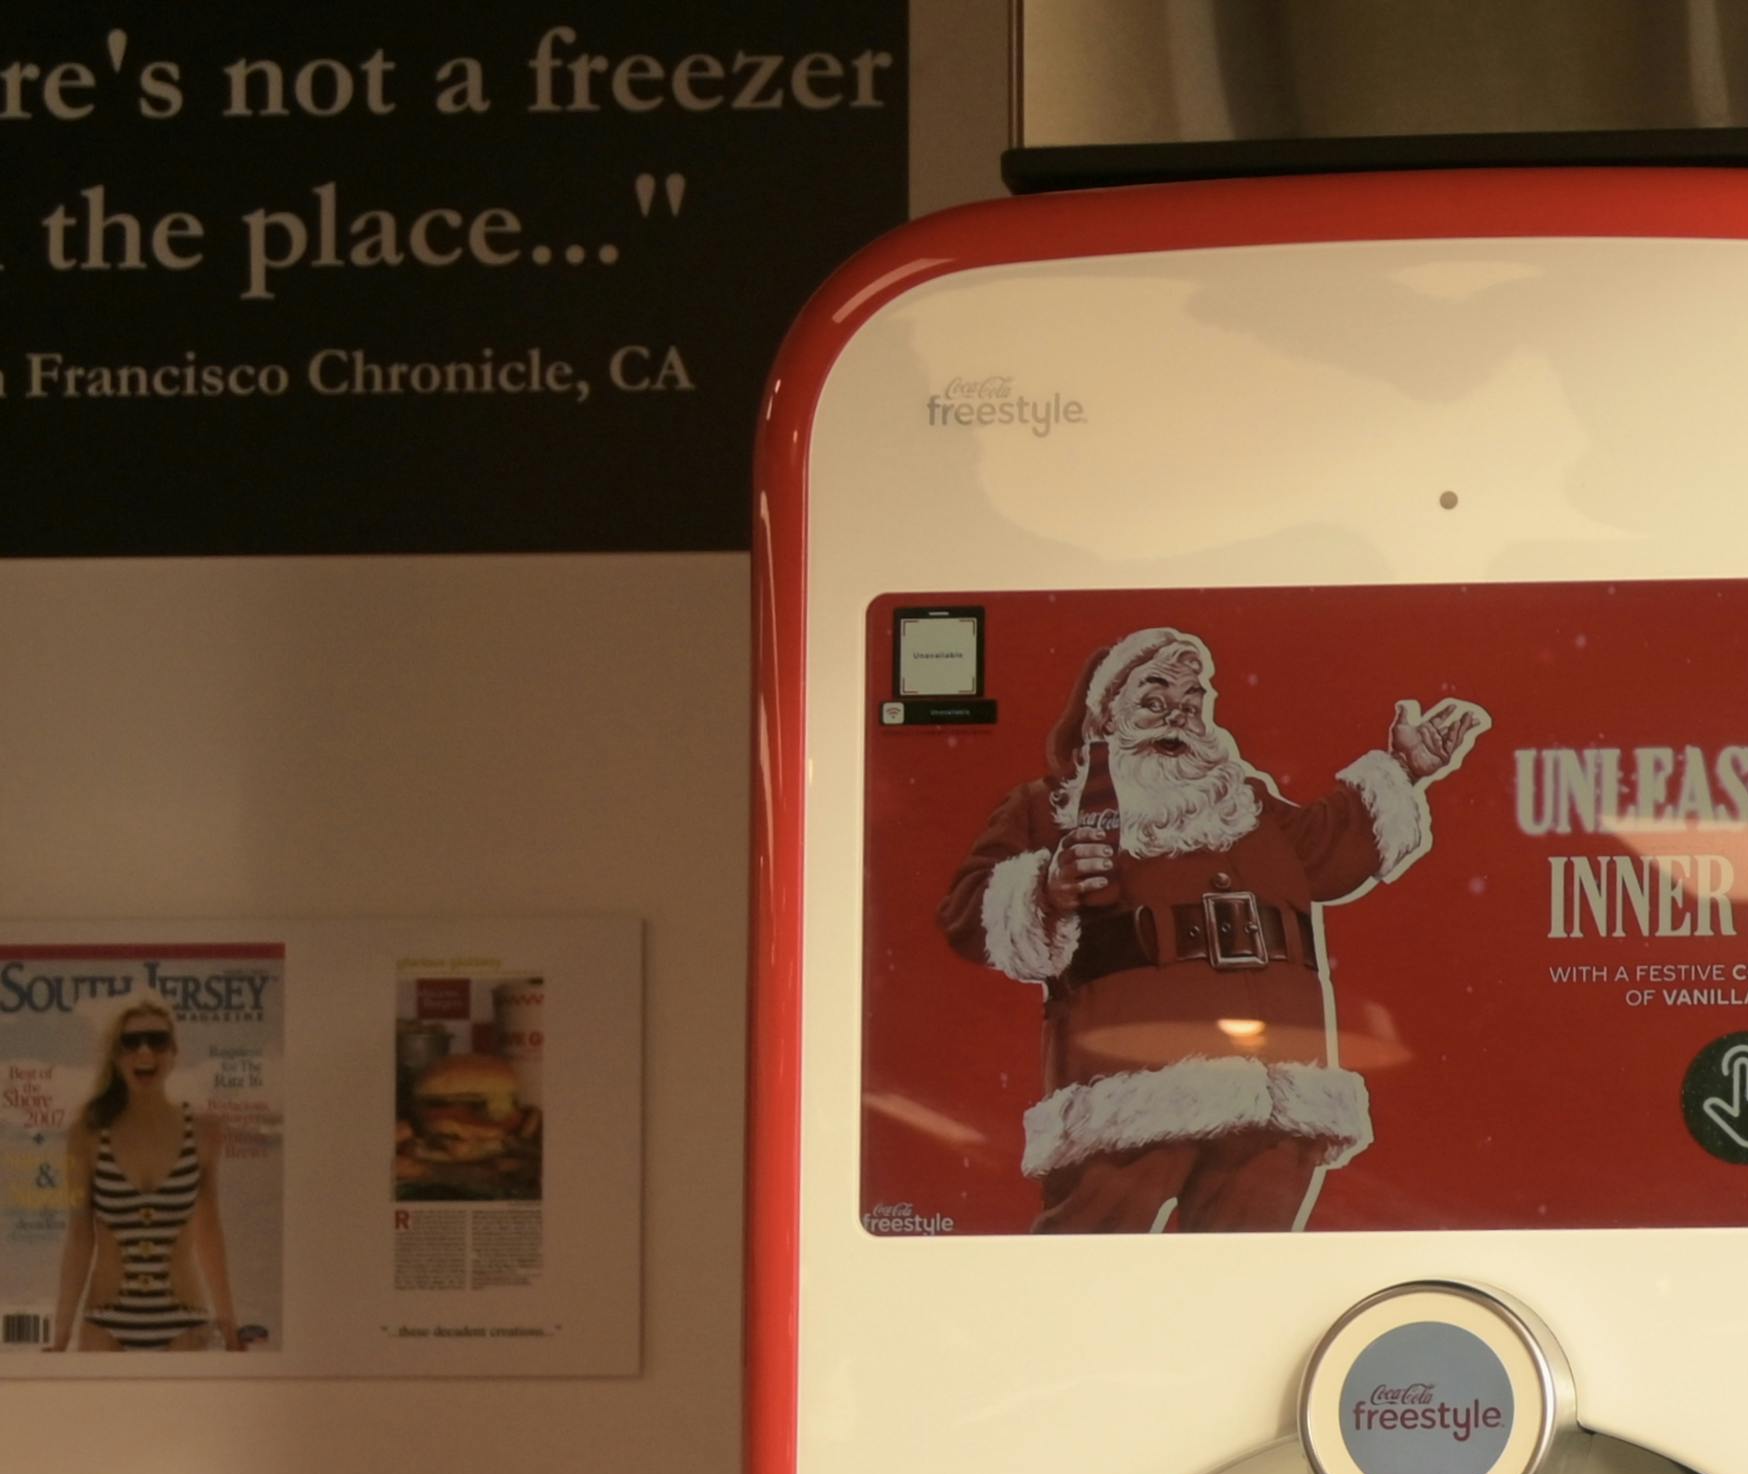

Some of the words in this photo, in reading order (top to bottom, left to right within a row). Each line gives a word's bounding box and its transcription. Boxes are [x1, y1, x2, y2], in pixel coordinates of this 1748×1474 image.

[0, 29, 184, 120] re's
[223, 48, 397, 117] not
[435, 56, 491, 114] a
[528, 27, 893, 114] freezer
[42, 185, 204, 270] the
[241, 172, 687, 300] place..."
[26, 353, 289, 398] Francisco
[308, 349, 591, 403] Chronicle,
[609, 346, 696, 391] CA
[926, 392, 1085, 438] freestyle
[1547, 854, 1737, 939] INNER
[1549, 965, 1608, 983] WITH
[1614, 965, 1630, 982] A
[1636, 964, 1727, 983] FESTIVE
[1625, 988, 1656, 1007] OF
[8, 1066, 37, 1079] Best
[39, 1065, 53, 1079] of
[395, 1210, 411, 1230] R
[1353, 1399, 1502, 1442] freestyle
